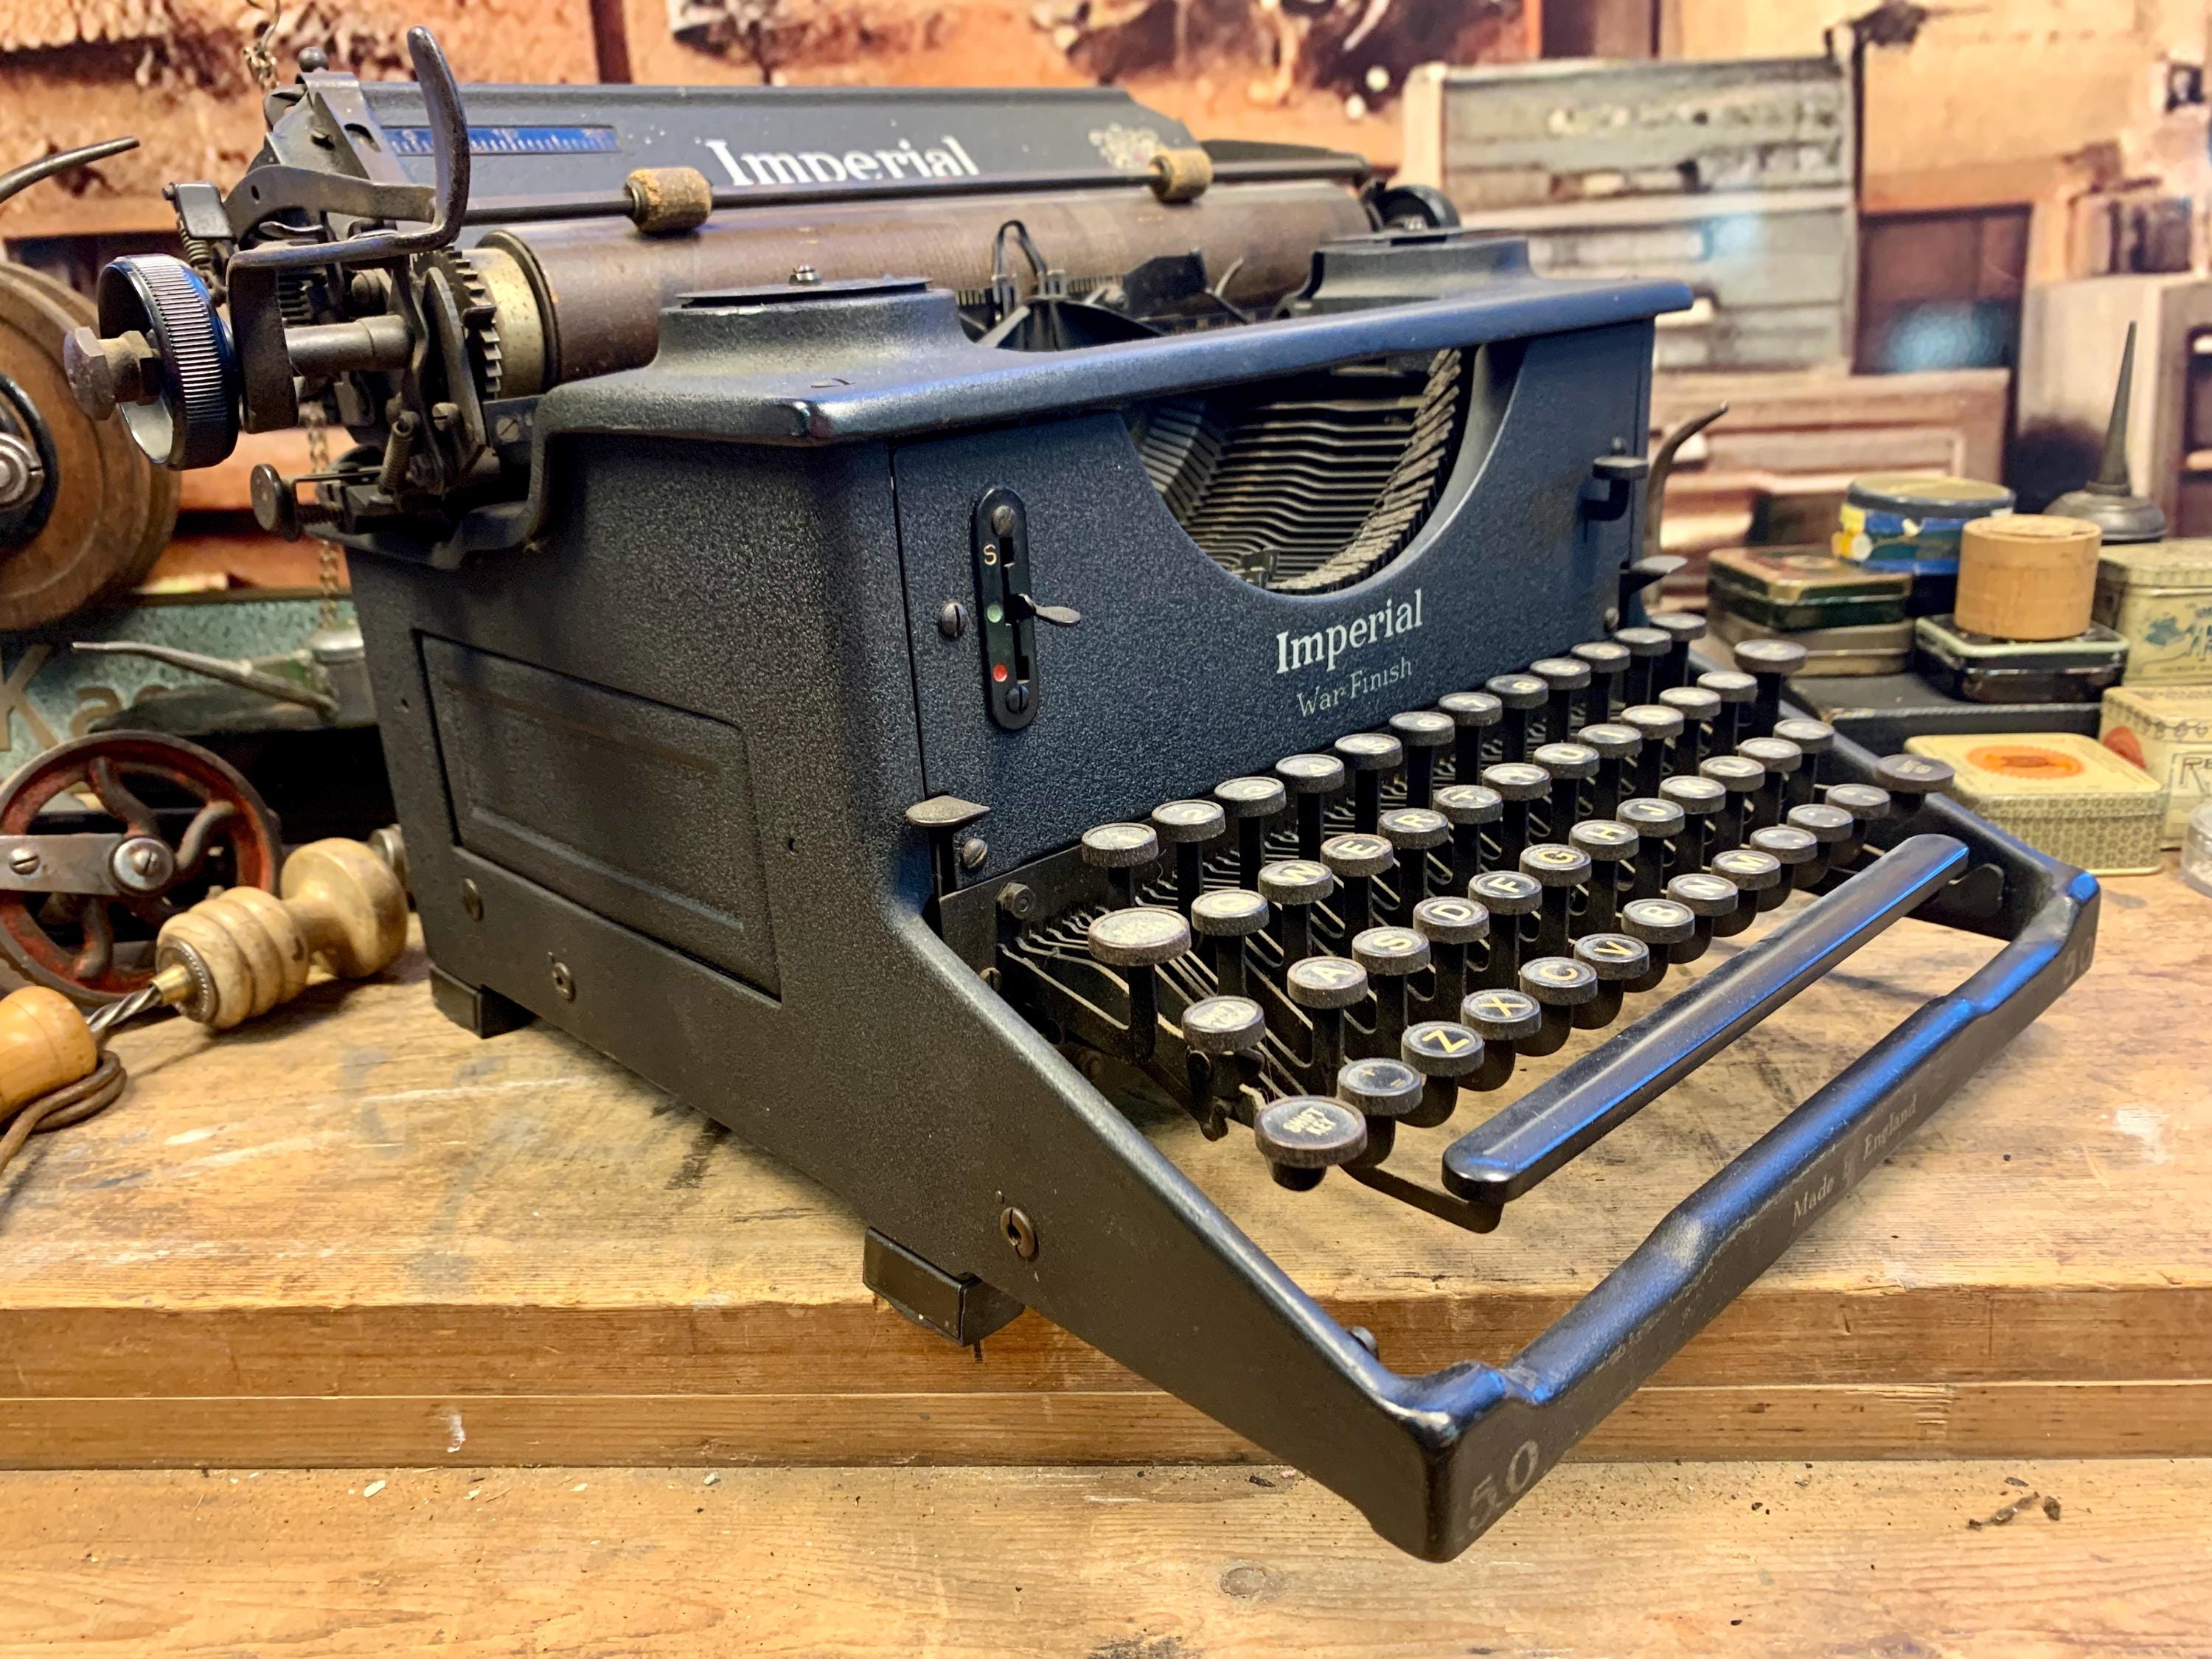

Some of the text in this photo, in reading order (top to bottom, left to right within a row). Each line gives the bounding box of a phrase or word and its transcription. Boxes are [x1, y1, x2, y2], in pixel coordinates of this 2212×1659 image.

[705, 135, 979, 186] Imperial
[983, 543, 998, 566] S
[1276, 588, 1422, 674] Imperial
[1296, 656, 1413, 717] War Finish
[1337, 841, 1379, 856] E
[1394, 814, 1435, 828] R
[1310, 965, 1352, 984] A
[1372, 934, 1413, 951] S
[1430, 904, 1472, 922] D
[1486, 876, 1520, 894] F
[1537, 849, 1577, 864] G
[1584, 824, 1627, 841] H
[1638, 804, 1667, 816] J
[1421, 854, 1770, 1054] Z X C V B N M
[1792, 1093, 1918, 1226] Made England
[1468, 1439, 1539, 1530] 50
